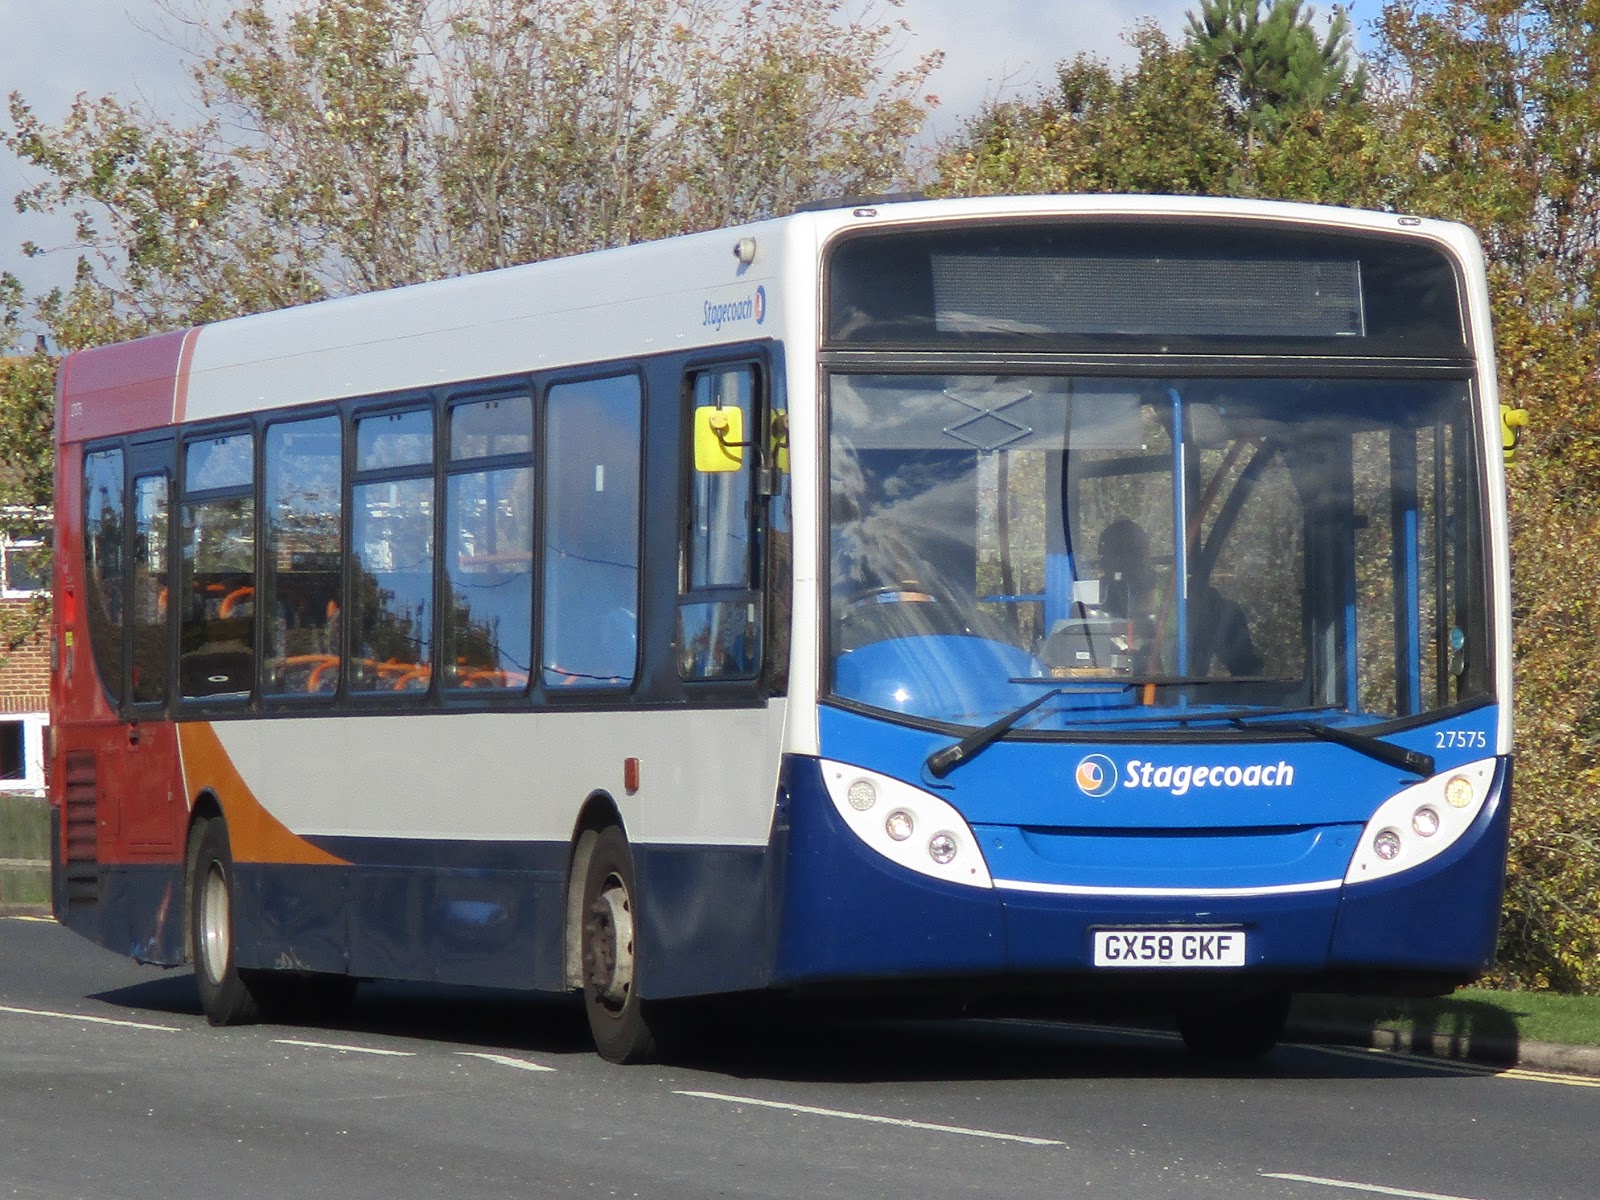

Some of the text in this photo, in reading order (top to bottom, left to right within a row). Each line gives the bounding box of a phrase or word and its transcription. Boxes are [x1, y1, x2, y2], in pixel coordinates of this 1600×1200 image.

[703, 296, 753, 331] Stagecoach
[1435, 731, 1487, 749] 27575
[1123, 760, 1294, 796] Stagecoach
[1105, 935, 1233, 960] GX58 GKF
